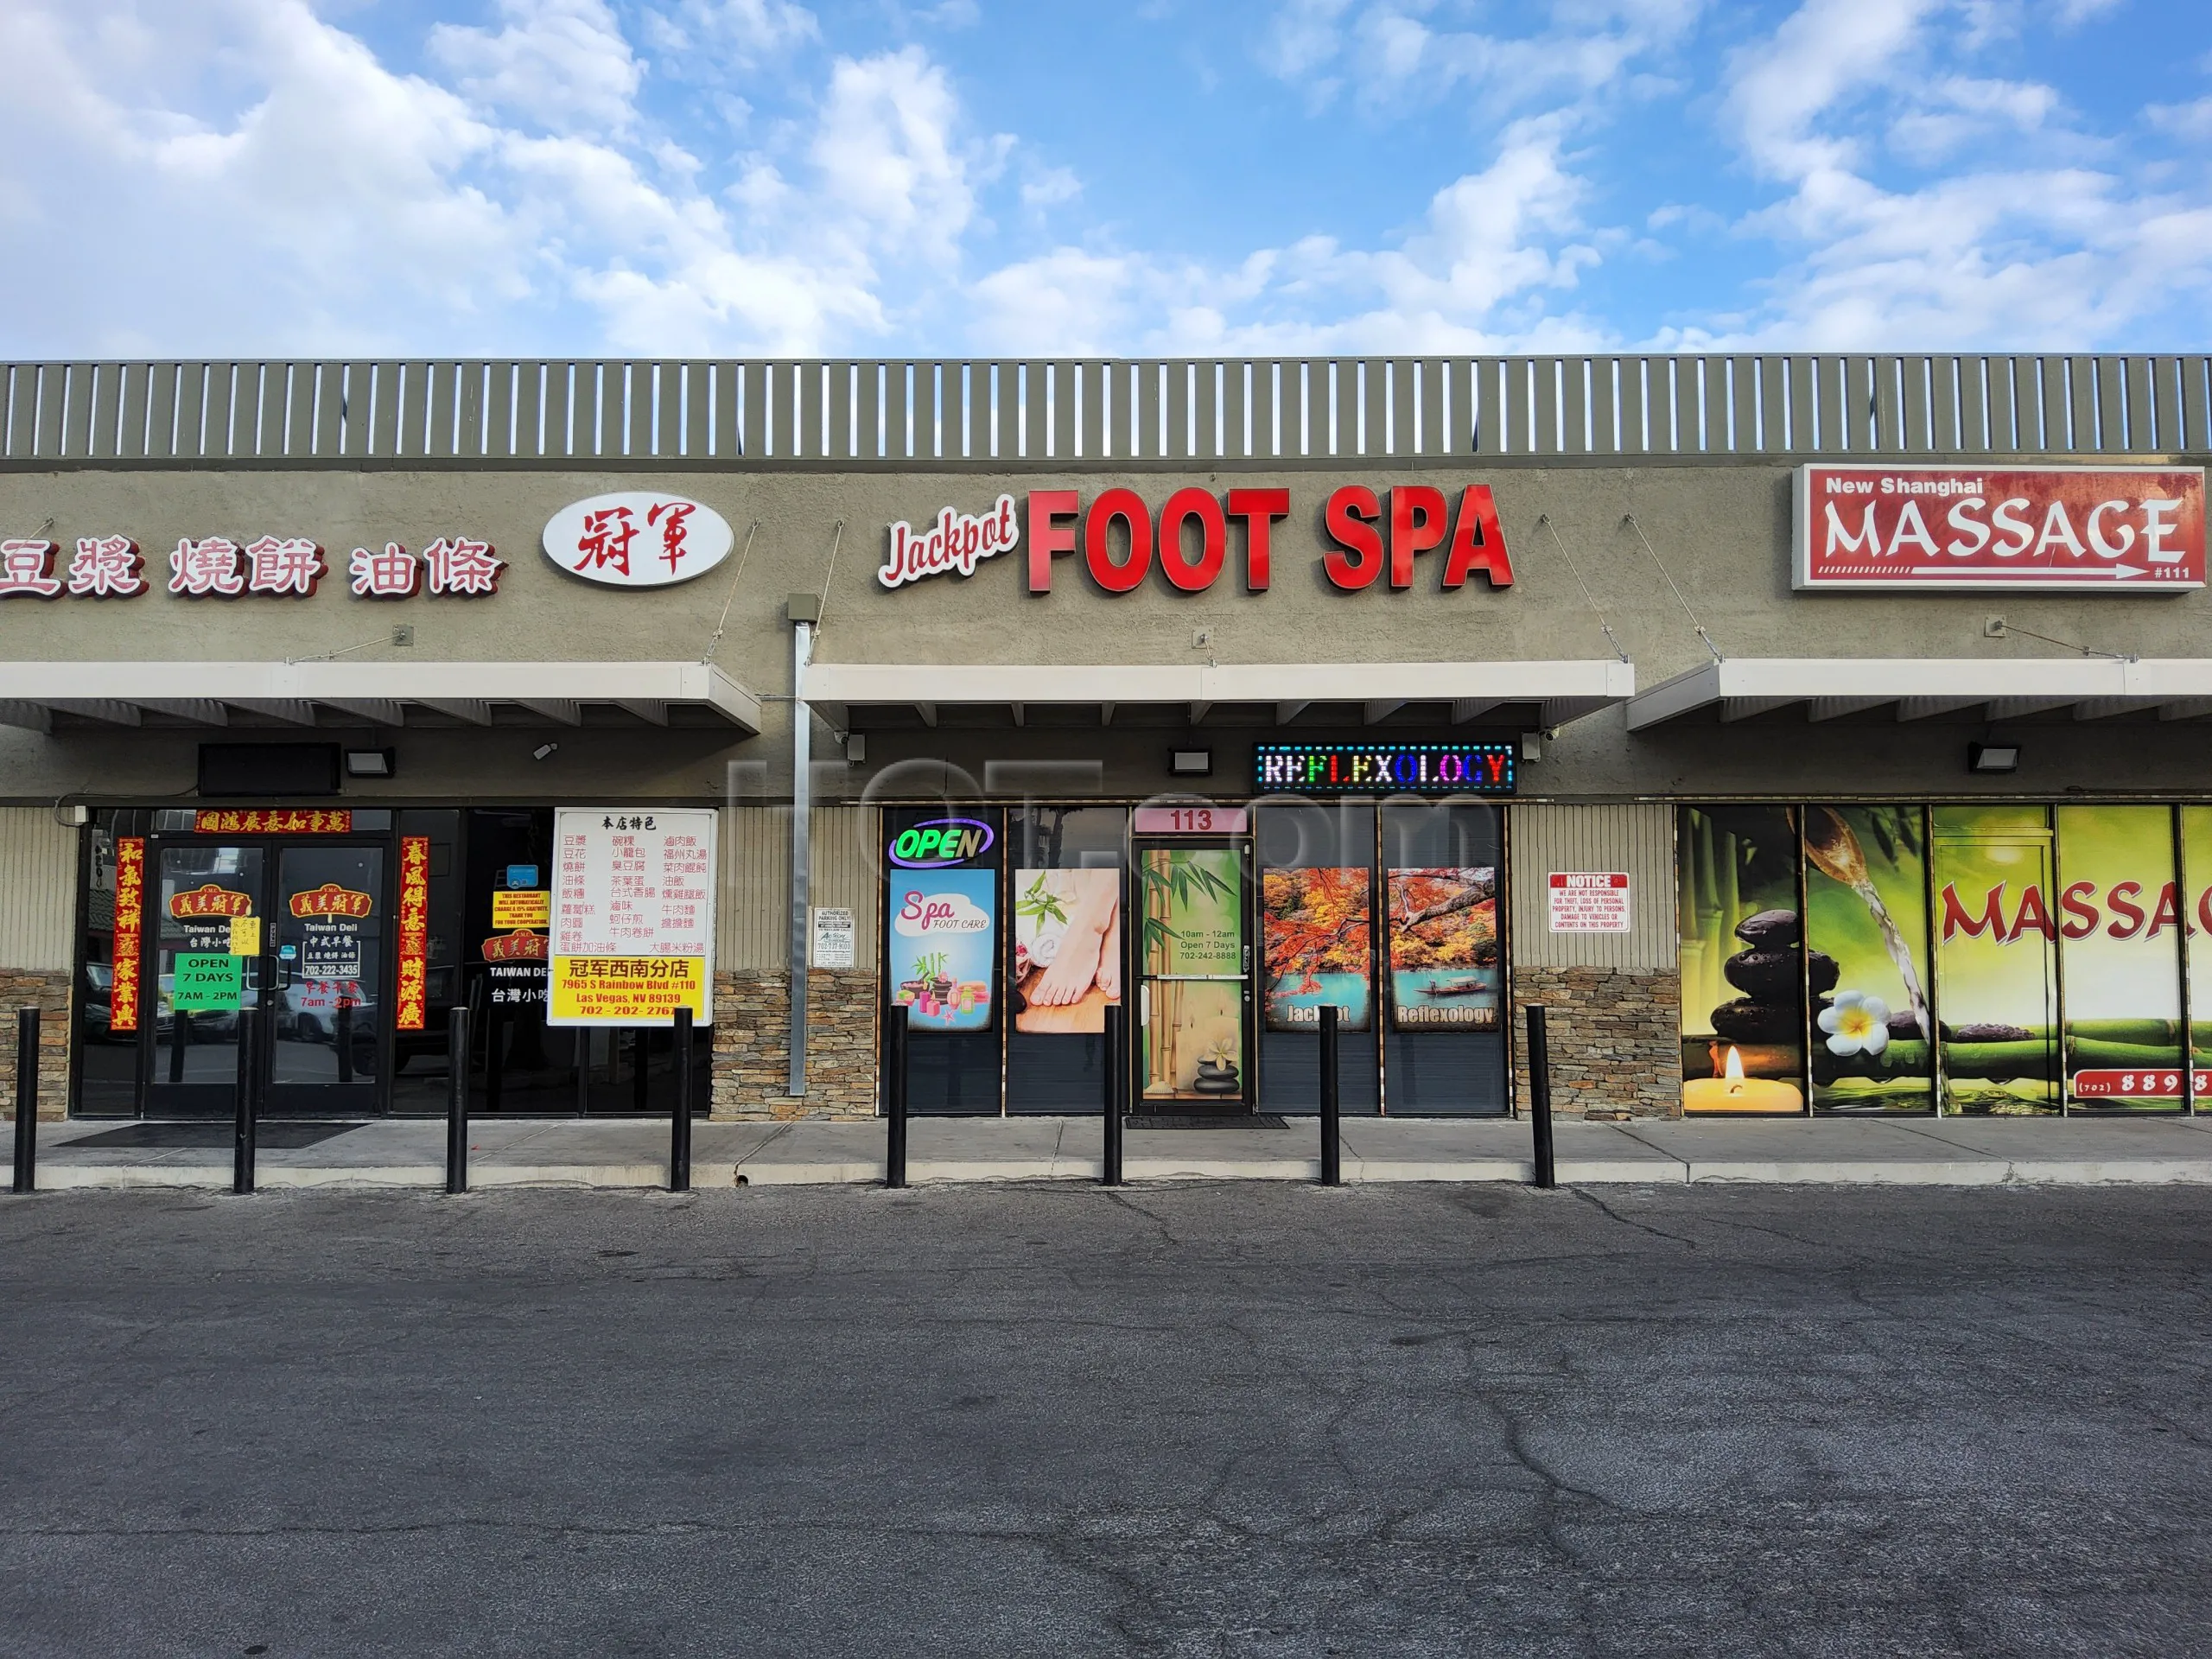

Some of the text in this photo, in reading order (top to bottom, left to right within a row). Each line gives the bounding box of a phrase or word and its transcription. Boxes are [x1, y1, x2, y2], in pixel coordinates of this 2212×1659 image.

[1826, 477, 1983, 497] New Shanghai
[1825, 498, 2186, 563] MASSAGE
[573, 502, 696, 576] 冠軍
[880, 484, 1516, 593] Jackpot FOOT SPA
[0, 535, 495, 596] 豆漿 燒餅 油條
[2154, 567, 2190, 579] #111
[1265, 753, 1505, 782] REFLEXOLOGY
[601, 816, 657, 830] 本店特色
[1170, 810, 1211, 830] 113
[895, 830, 982, 858] OPEN
[563, 848, 587, 860] 豆花
[664, 849, 708, 861] 福州丸湯
[611, 875, 645, 887] 茶葉蛋
[662, 875, 685, 887] 油飯
[1567, 875, 1611, 887] NOTICE
[179, 894, 245, 915] 義美冠軍
[300, 893, 365, 914] 義美冠軍
[901, 891, 955, 930] Spa
[1942, 880, 2212, 947] MASSA
[933, 919, 987, 929] FOOT CARE
[309, 935, 353, 947] 中式早餐
[1180, 941, 1204, 950] Open
[1213, 941, 1235, 950] Days
[188, 959, 229, 968] OPEN
[305, 964, 358, 975] 702-222-3435
[569, 959, 690, 978] 冠军西南分店
[183, 973, 233, 982] 7 DAYS
[490, 968, 549, 977] TAIWAN DE
[562, 980, 696, 990] 7965 S Rainbow Blvd #110
[301, 997, 325, 1007] 7am
[576, 994, 681, 1005] Las Vegas, NV 89139
[580, 1006, 603, 1015] 702
[1396, 1005, 1495, 1024] Reflexology
[2079, 1082, 2111, 1092] (702)
